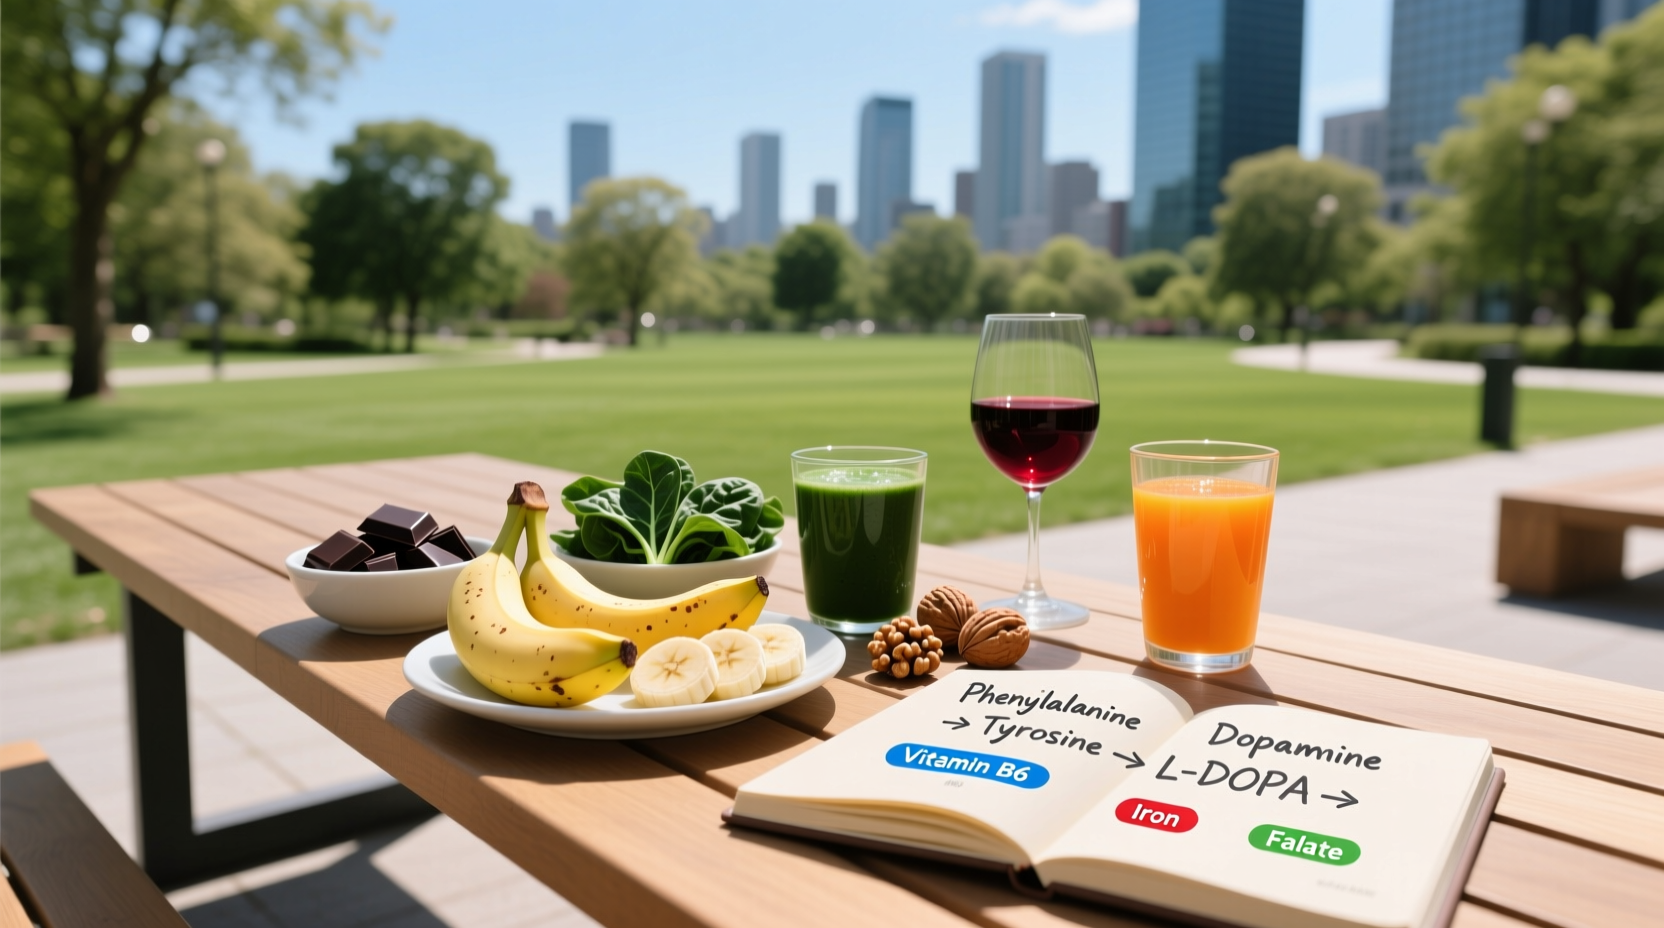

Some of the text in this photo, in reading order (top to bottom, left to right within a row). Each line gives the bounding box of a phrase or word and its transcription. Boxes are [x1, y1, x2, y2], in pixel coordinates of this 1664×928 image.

[959, 682, 1141, 730] Phenylalanine
[983, 715, 1103, 755] Tyrosine
[904, 746, 1031, 783] Vitamin B6
[1155, 754, 1309, 804] L-DOPA
[1131, 803, 1180, 828] Iron
[1265, 829, 1344, 861] Falate
